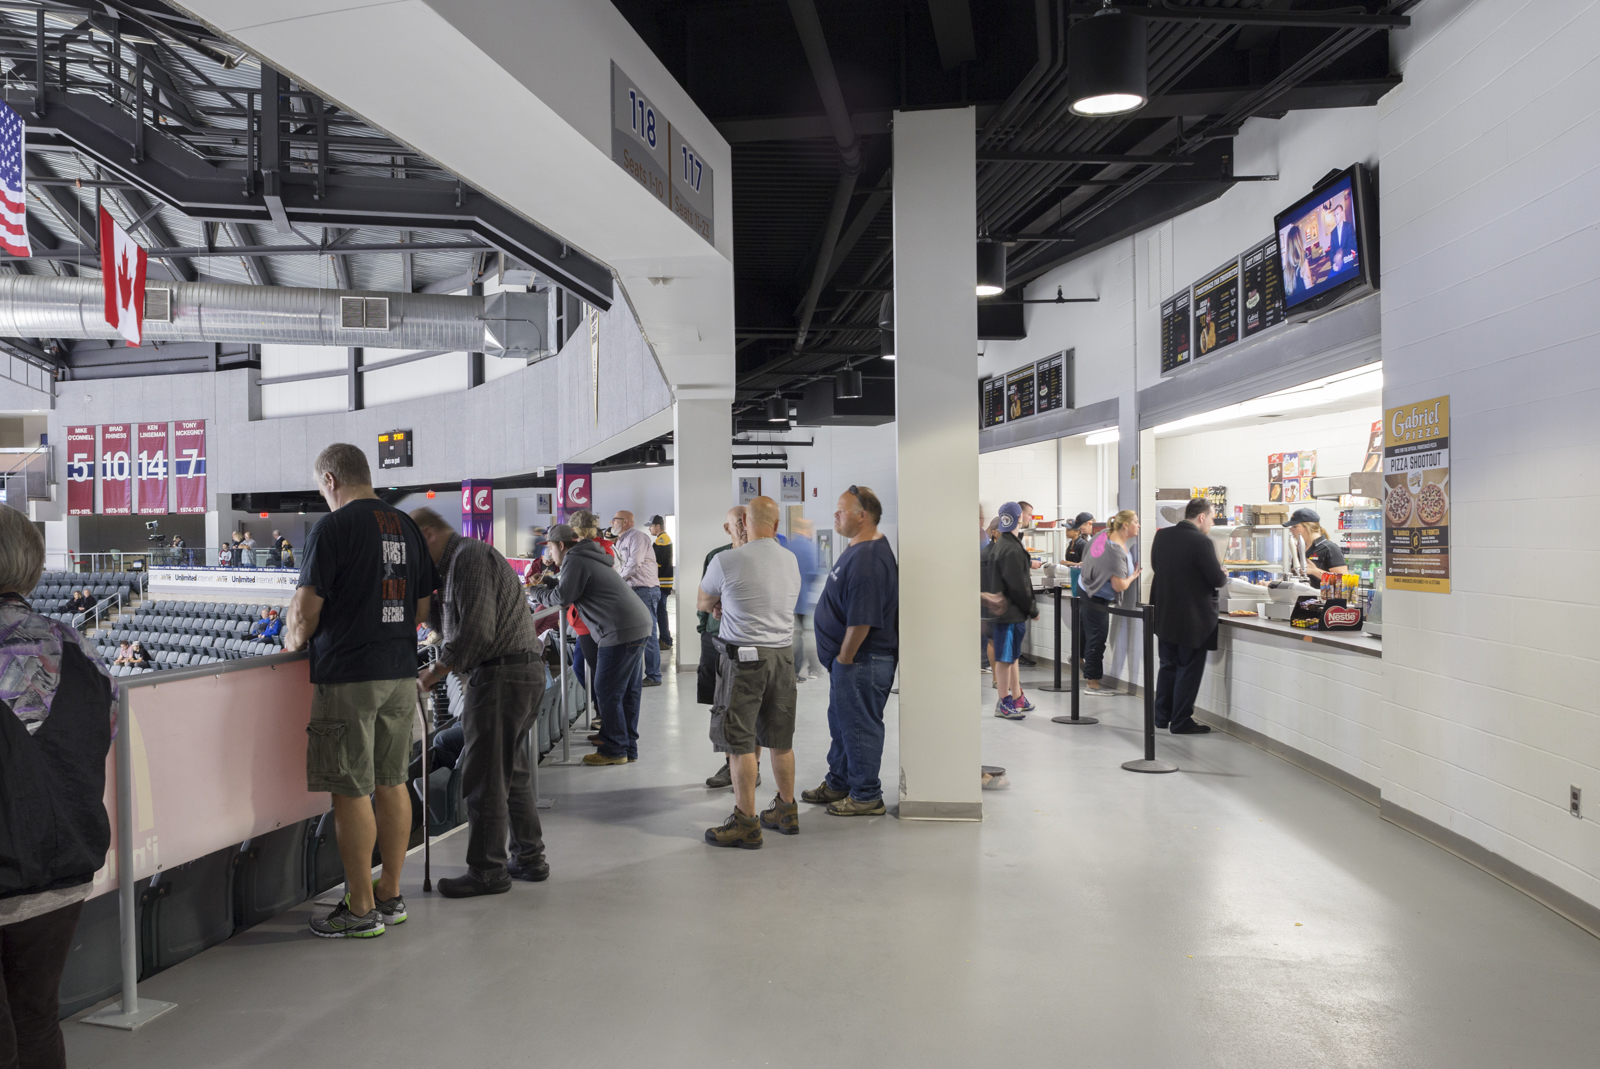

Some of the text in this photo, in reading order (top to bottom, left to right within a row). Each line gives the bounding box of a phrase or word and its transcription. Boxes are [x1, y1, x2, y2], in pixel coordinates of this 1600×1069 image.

[628, 87, 658, 151] 118
[623, 148, 664, 200] Seats 1-10
[681, 144, 703, 195] 117
[674, 195, 710, 240] Seats 11-23
[1391, 401, 1441, 438] Gabriel
[1405, 426, 1440, 442] PIZZA
[72, 453, 89, 483] 5
[103, 451, 130, 481] 10
[138, 450, 167, 481] 14
[182, 448, 199, 479] 7
[1390, 452, 1441, 472] PIZZA SHOOTOUT
[373, 510, 403, 534] PLAY
[175, 573, 198, 582] Unlimited
[232, 575, 256, 584] Unlimited
[256, 576, 273, 584] Internet
